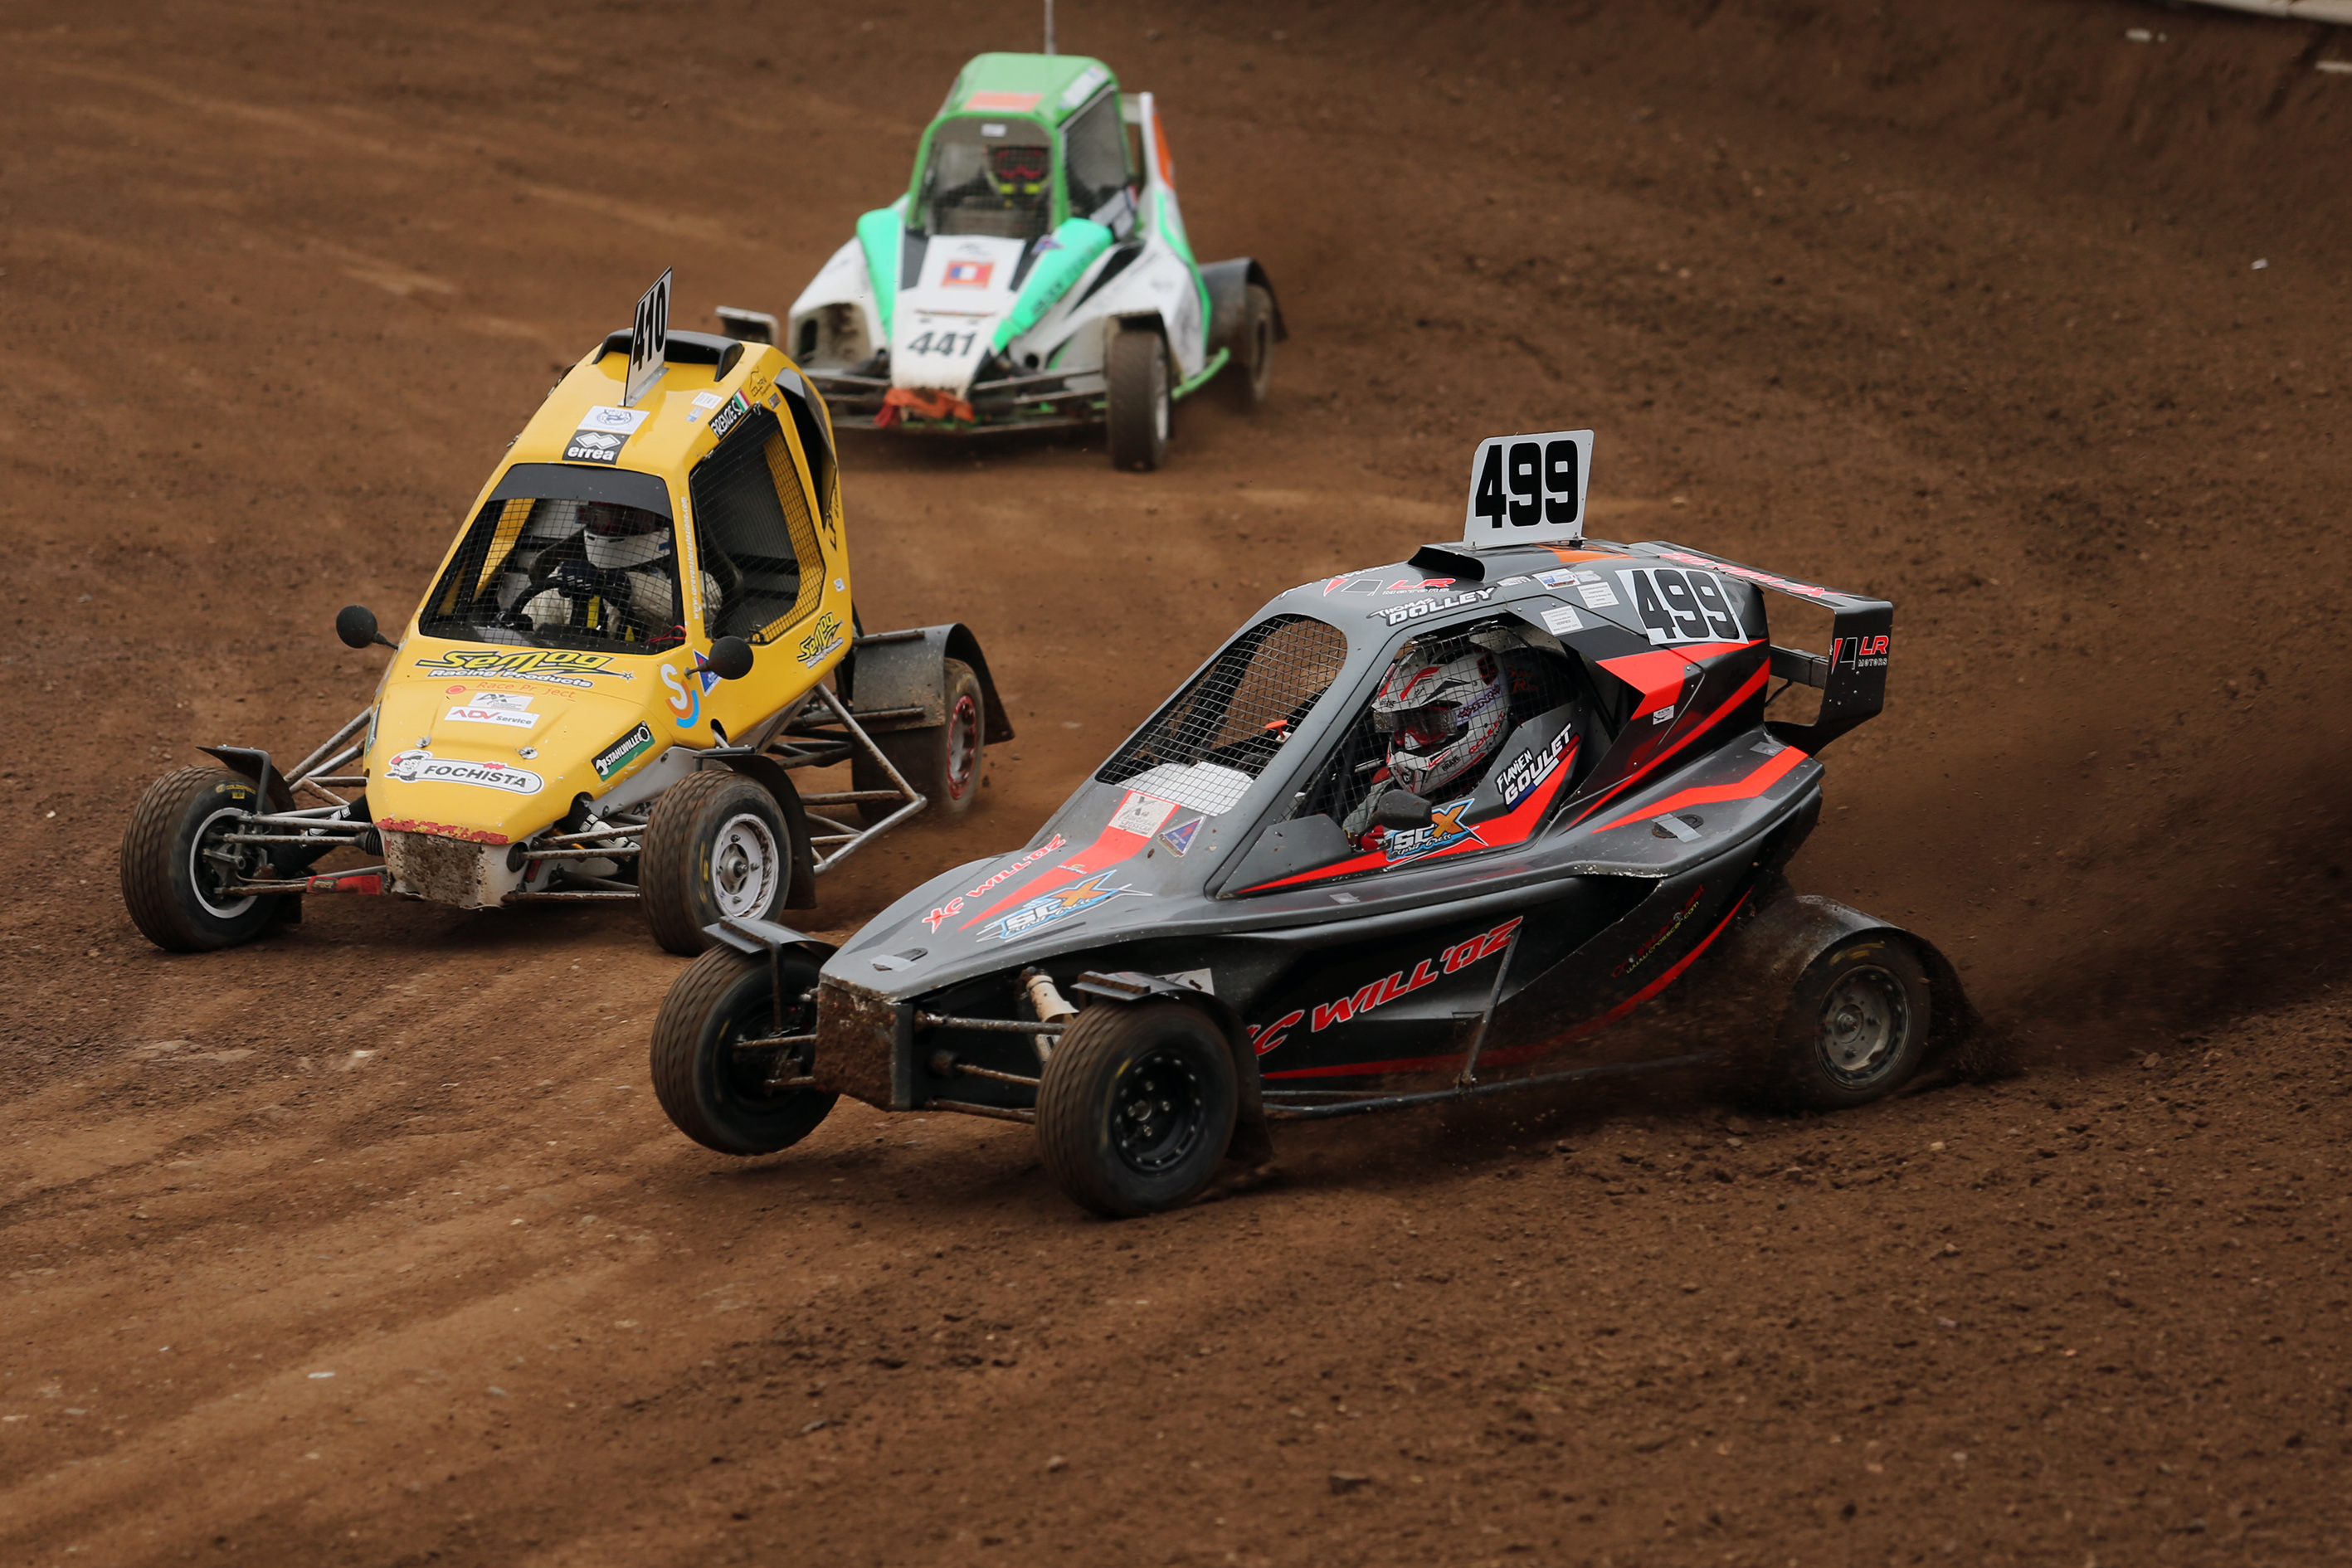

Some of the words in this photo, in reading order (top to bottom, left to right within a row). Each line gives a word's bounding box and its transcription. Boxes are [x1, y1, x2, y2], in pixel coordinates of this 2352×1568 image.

[633, 281, 666, 372] 410
[907, 332, 976, 356] 441
[1475, 440, 1579, 529] 499
[1386, 577, 1457, 590] LR
[1369, 597, 1435, 618] THOMAS
[1388, 587, 1497, 626] DOLLEY
[1632, 569, 1741, 640] 499
[1859, 635, 1889, 655] LR
[1858, 657, 1888, 668] MOTORS
[427, 669, 498, 678] Racing
[499, 670, 594, 688] Products
[476, 681, 515, 690] Race
[495, 715, 533, 725] Service
[603, 733, 642, 767] STAHLWILLE
[423, 764, 528, 789] FOCHISTA
[1504, 723, 1572, 806] GOULET
[922, 897, 965, 935] XC
[966, 833, 1067, 899] WILL'OZ
[1246, 1009, 1306, 1057] C
[1311, 915, 1524, 1034] WILL'OZ
